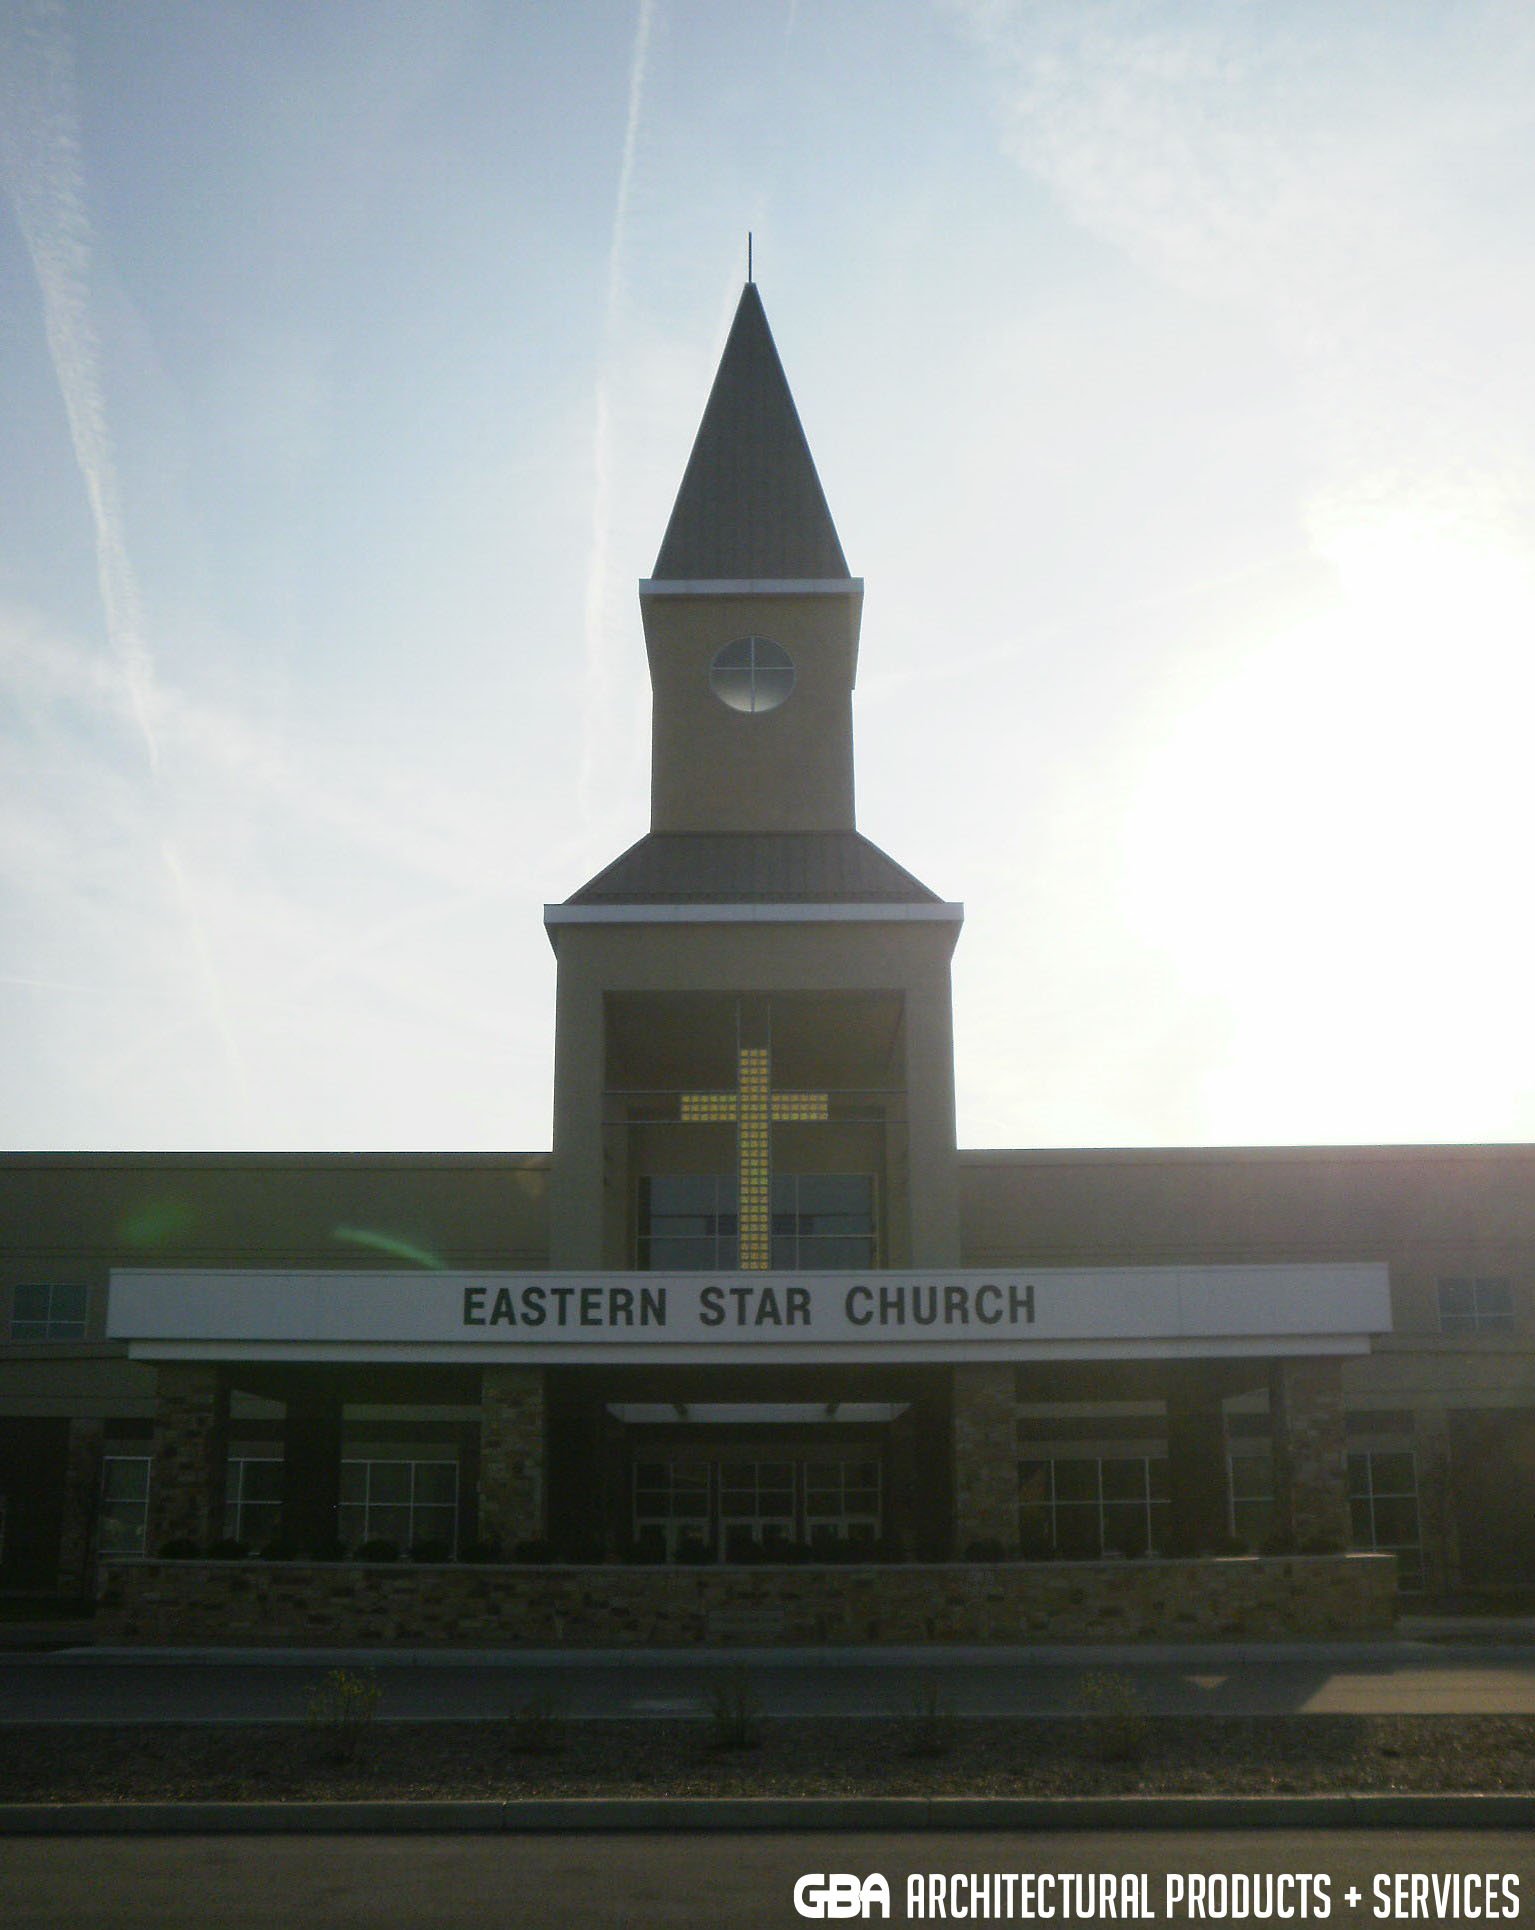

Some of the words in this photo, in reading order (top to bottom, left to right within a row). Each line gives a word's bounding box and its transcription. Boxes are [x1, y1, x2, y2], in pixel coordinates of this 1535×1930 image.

[463, 1287, 667, 1326] EASTERN
[700, 1286, 812, 1326] STAR
[845, 1285, 1035, 1325] CHURCH
